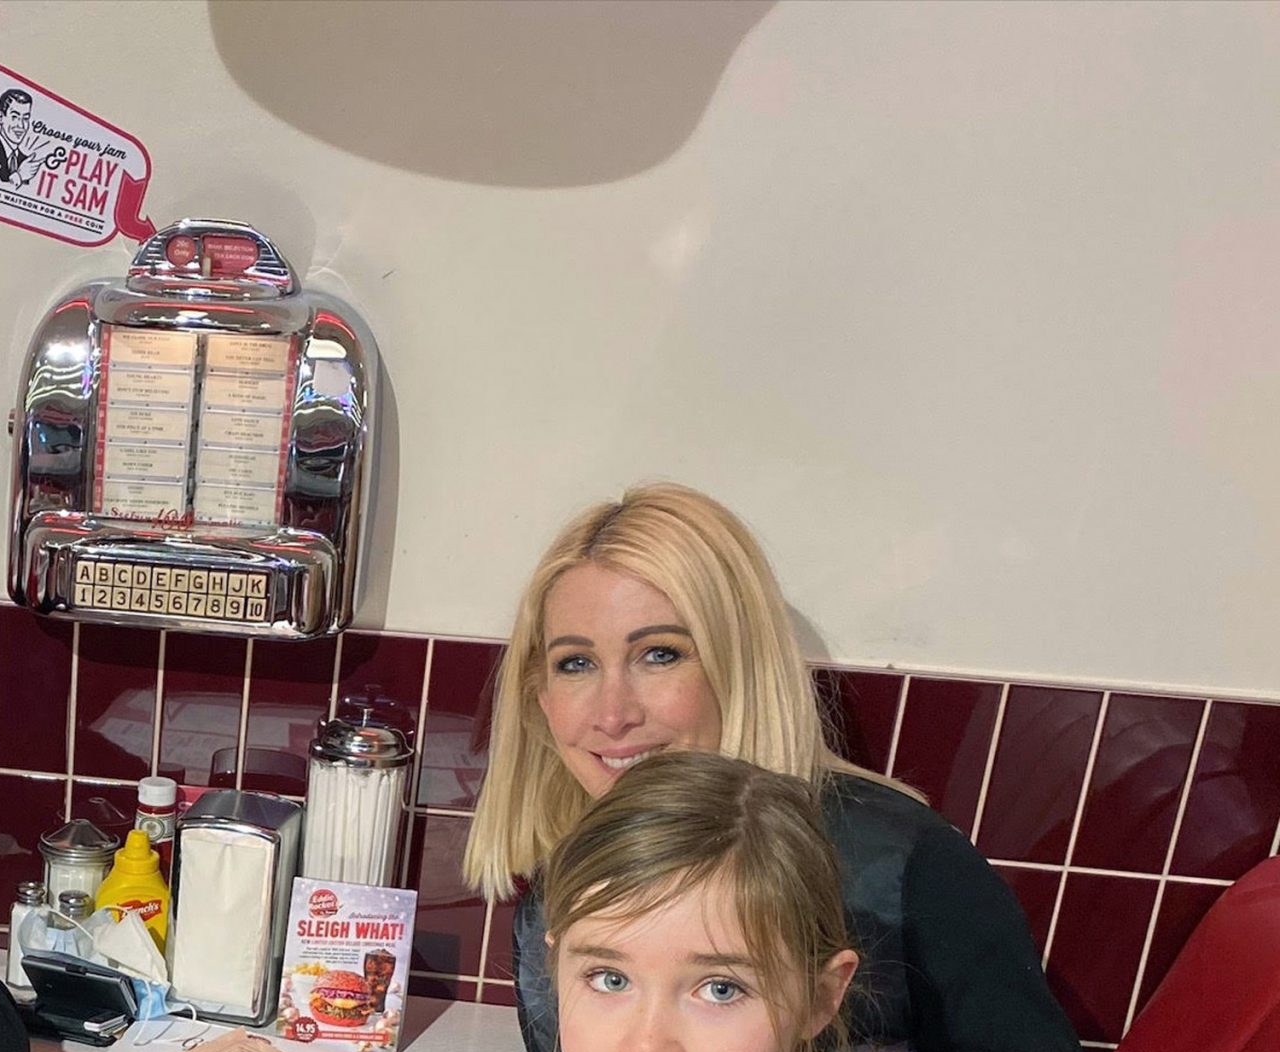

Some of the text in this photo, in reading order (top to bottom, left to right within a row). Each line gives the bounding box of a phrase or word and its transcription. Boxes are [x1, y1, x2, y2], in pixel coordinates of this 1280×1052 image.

[32, 120, 127, 160] Choose your jam
[45, 147, 118, 187] & PLAY
[36, 170, 109, 215] IT SAM
[40, 205, 56, 217] FOR
[64, 213, 83, 225] FREE
[80, 566, 261, 593] A B C D E F G H J K
[81, 589, 262, 617] 1 2 3 4 5 6 7 8 9 10
[297, 920, 405, 940] SLEIGH WHAT!
[295, 1023, 316, 1034] 14.95
